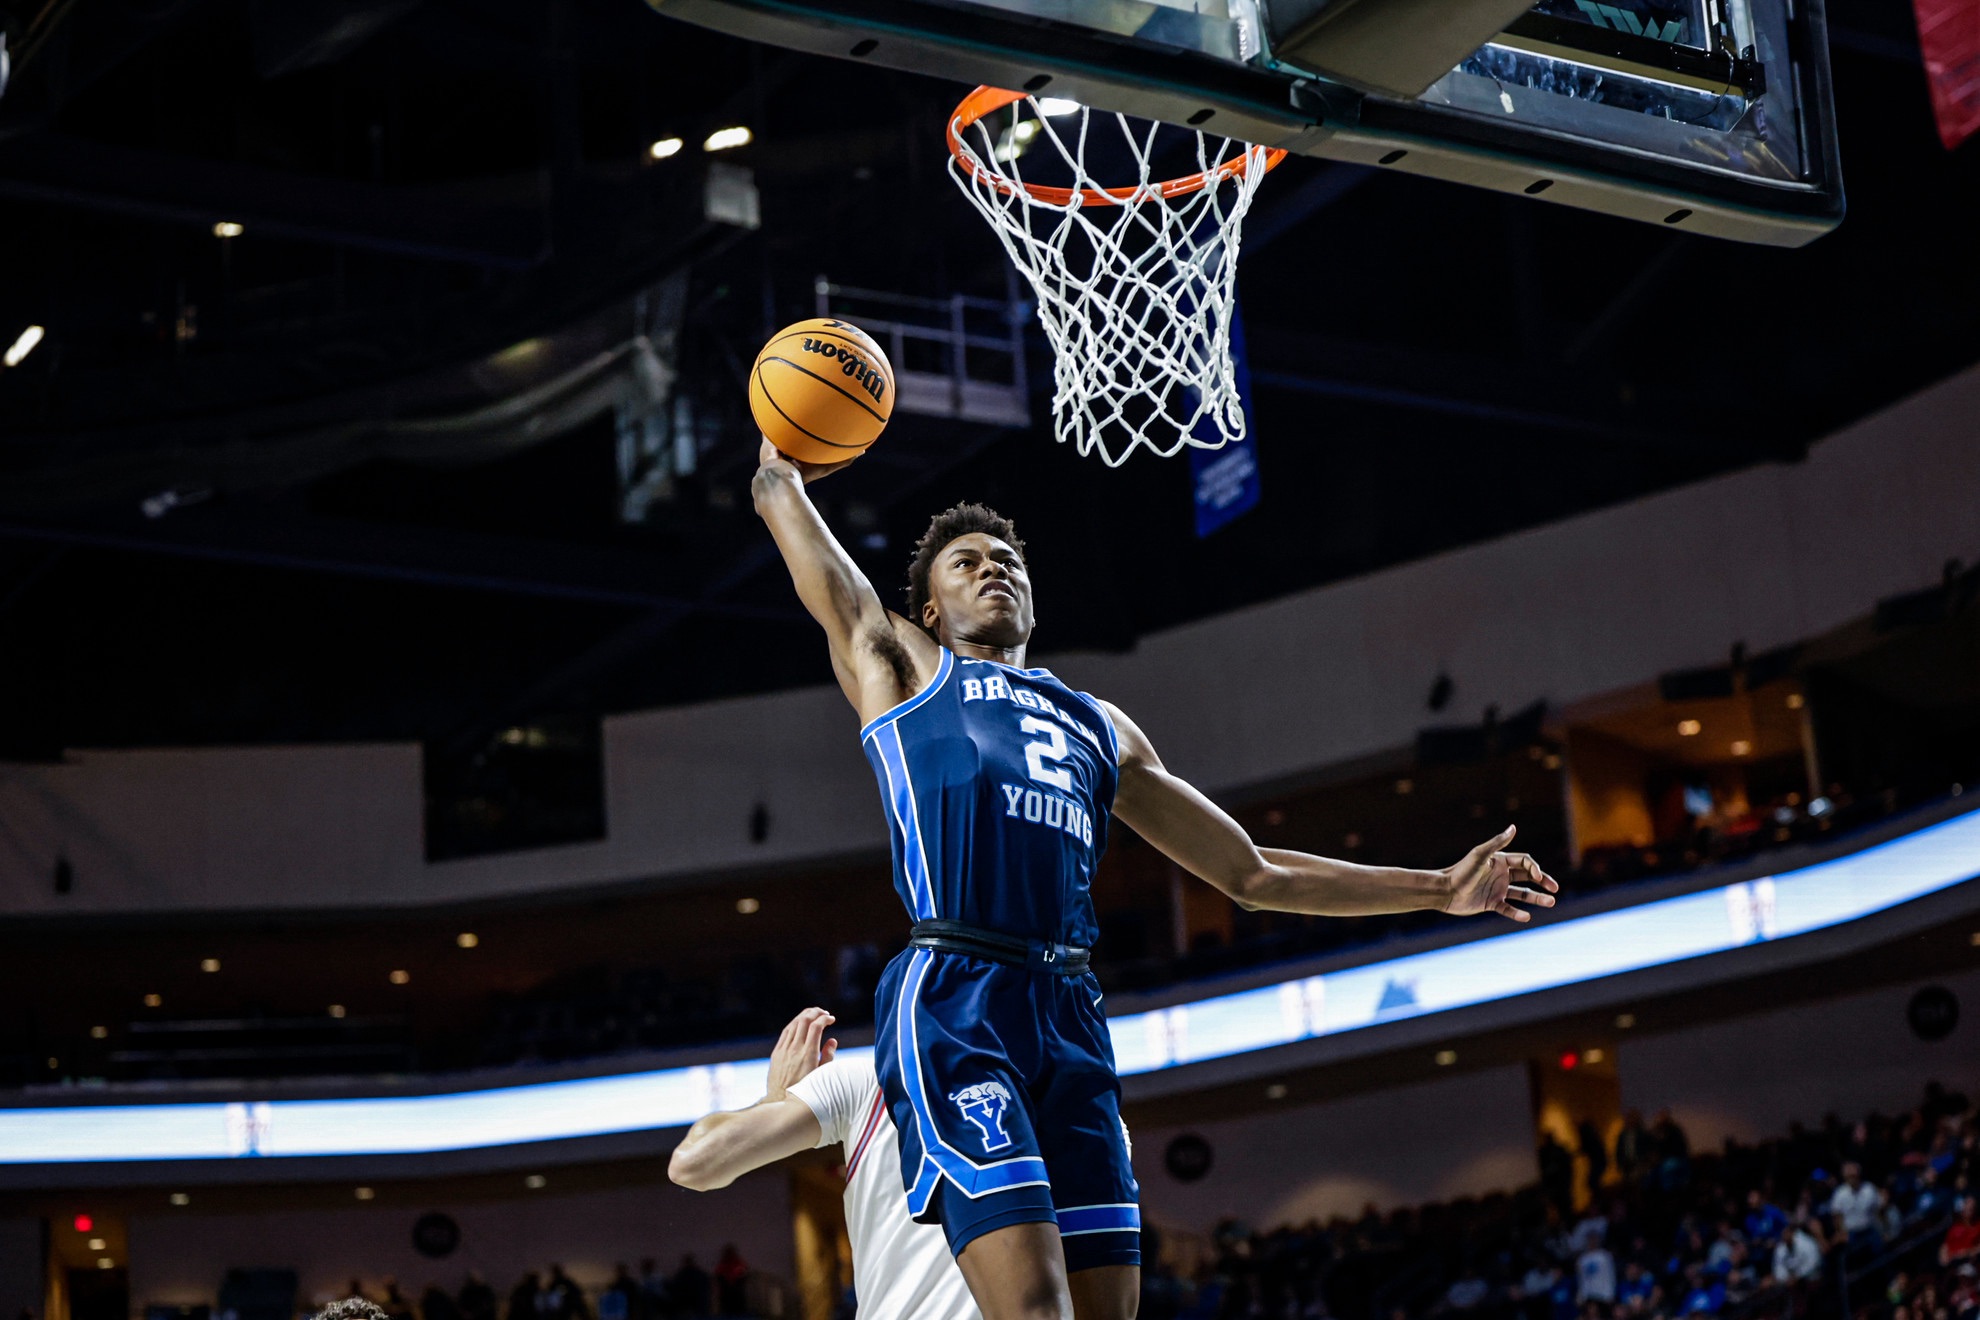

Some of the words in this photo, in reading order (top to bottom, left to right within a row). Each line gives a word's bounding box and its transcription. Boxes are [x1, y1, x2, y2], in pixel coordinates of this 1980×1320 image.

[802, 337, 885, 404] Wilson
[1019, 714, 1074, 794] 2
[1002, 783, 1094, 849] YOUNG
